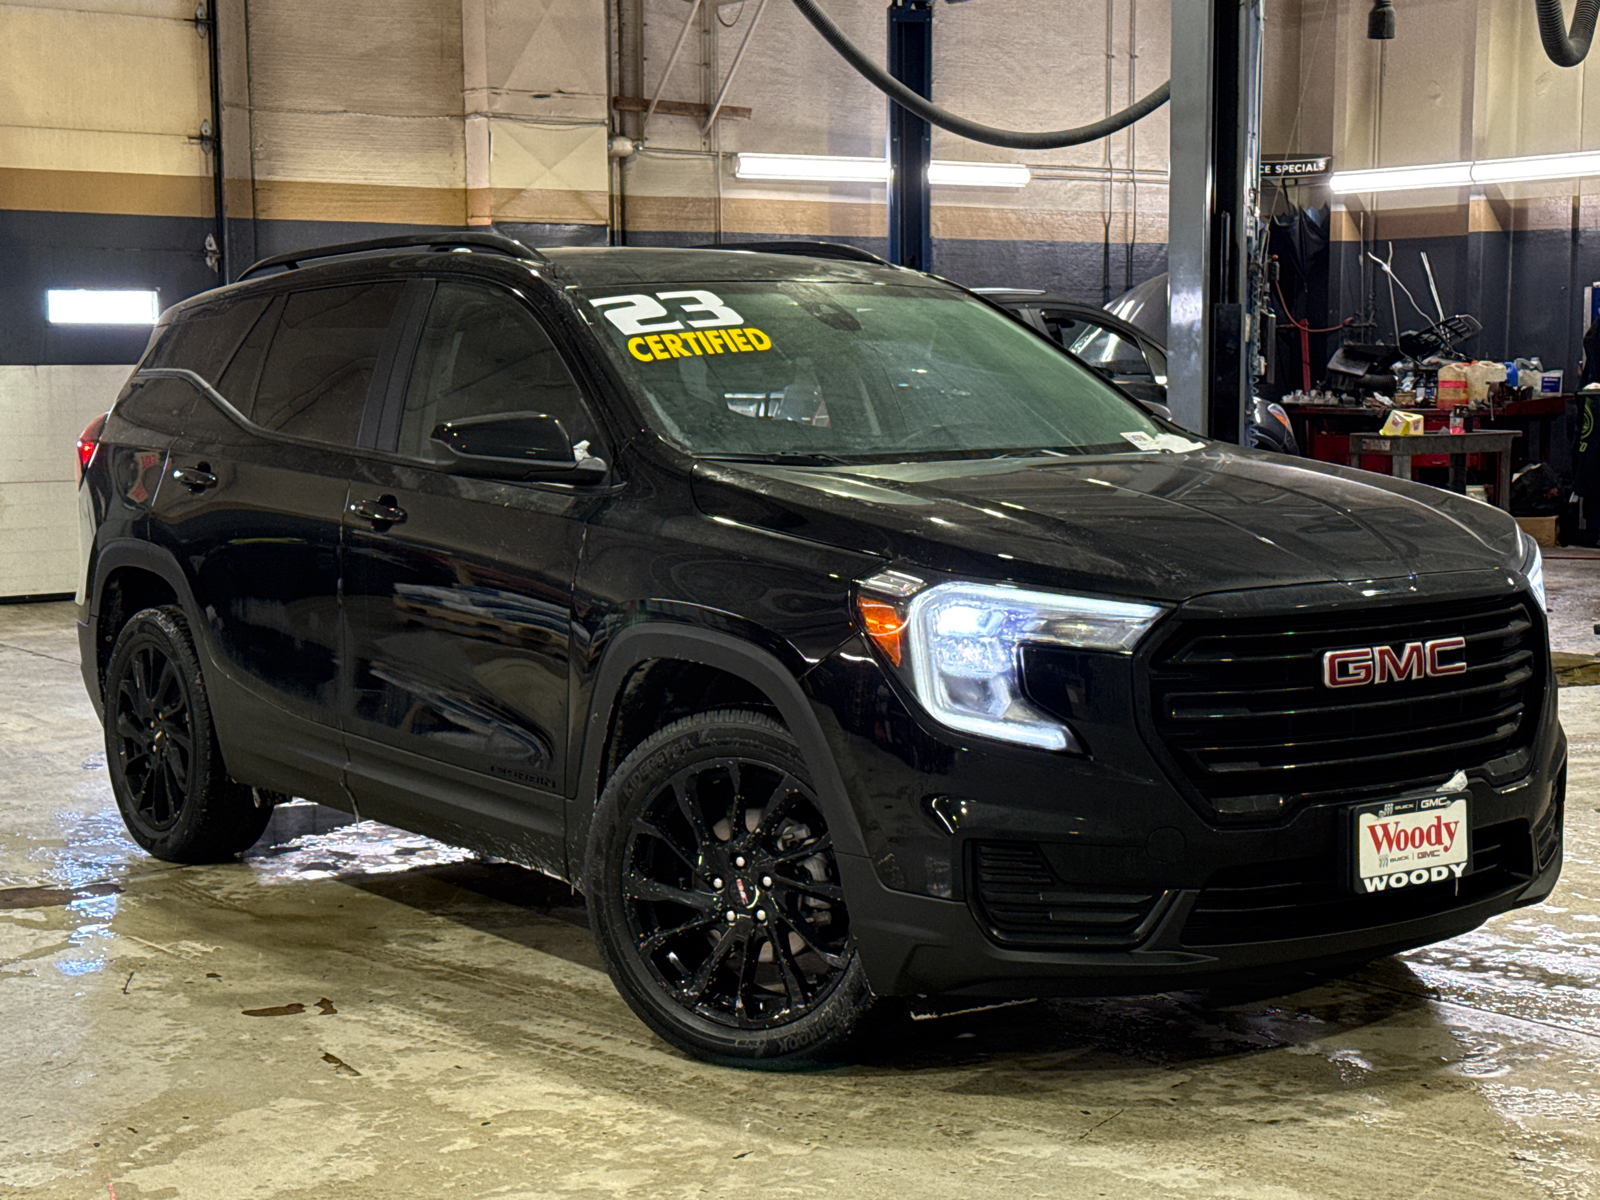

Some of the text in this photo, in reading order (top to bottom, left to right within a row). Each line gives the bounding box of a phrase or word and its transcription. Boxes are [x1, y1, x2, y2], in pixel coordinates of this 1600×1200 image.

[1275, 162, 1326, 174] SPECIALS
[588, 290, 745, 336] 23
[627, 327, 772, 363] CERTIFIED
[1323, 636, 1467, 689] GMC
[1420, 796, 1448, 809] GMC
[1366, 815, 1460, 855] Woody
[1417, 849, 1441, 860] GMC
[1363, 862, 1468, 893] WOODY
